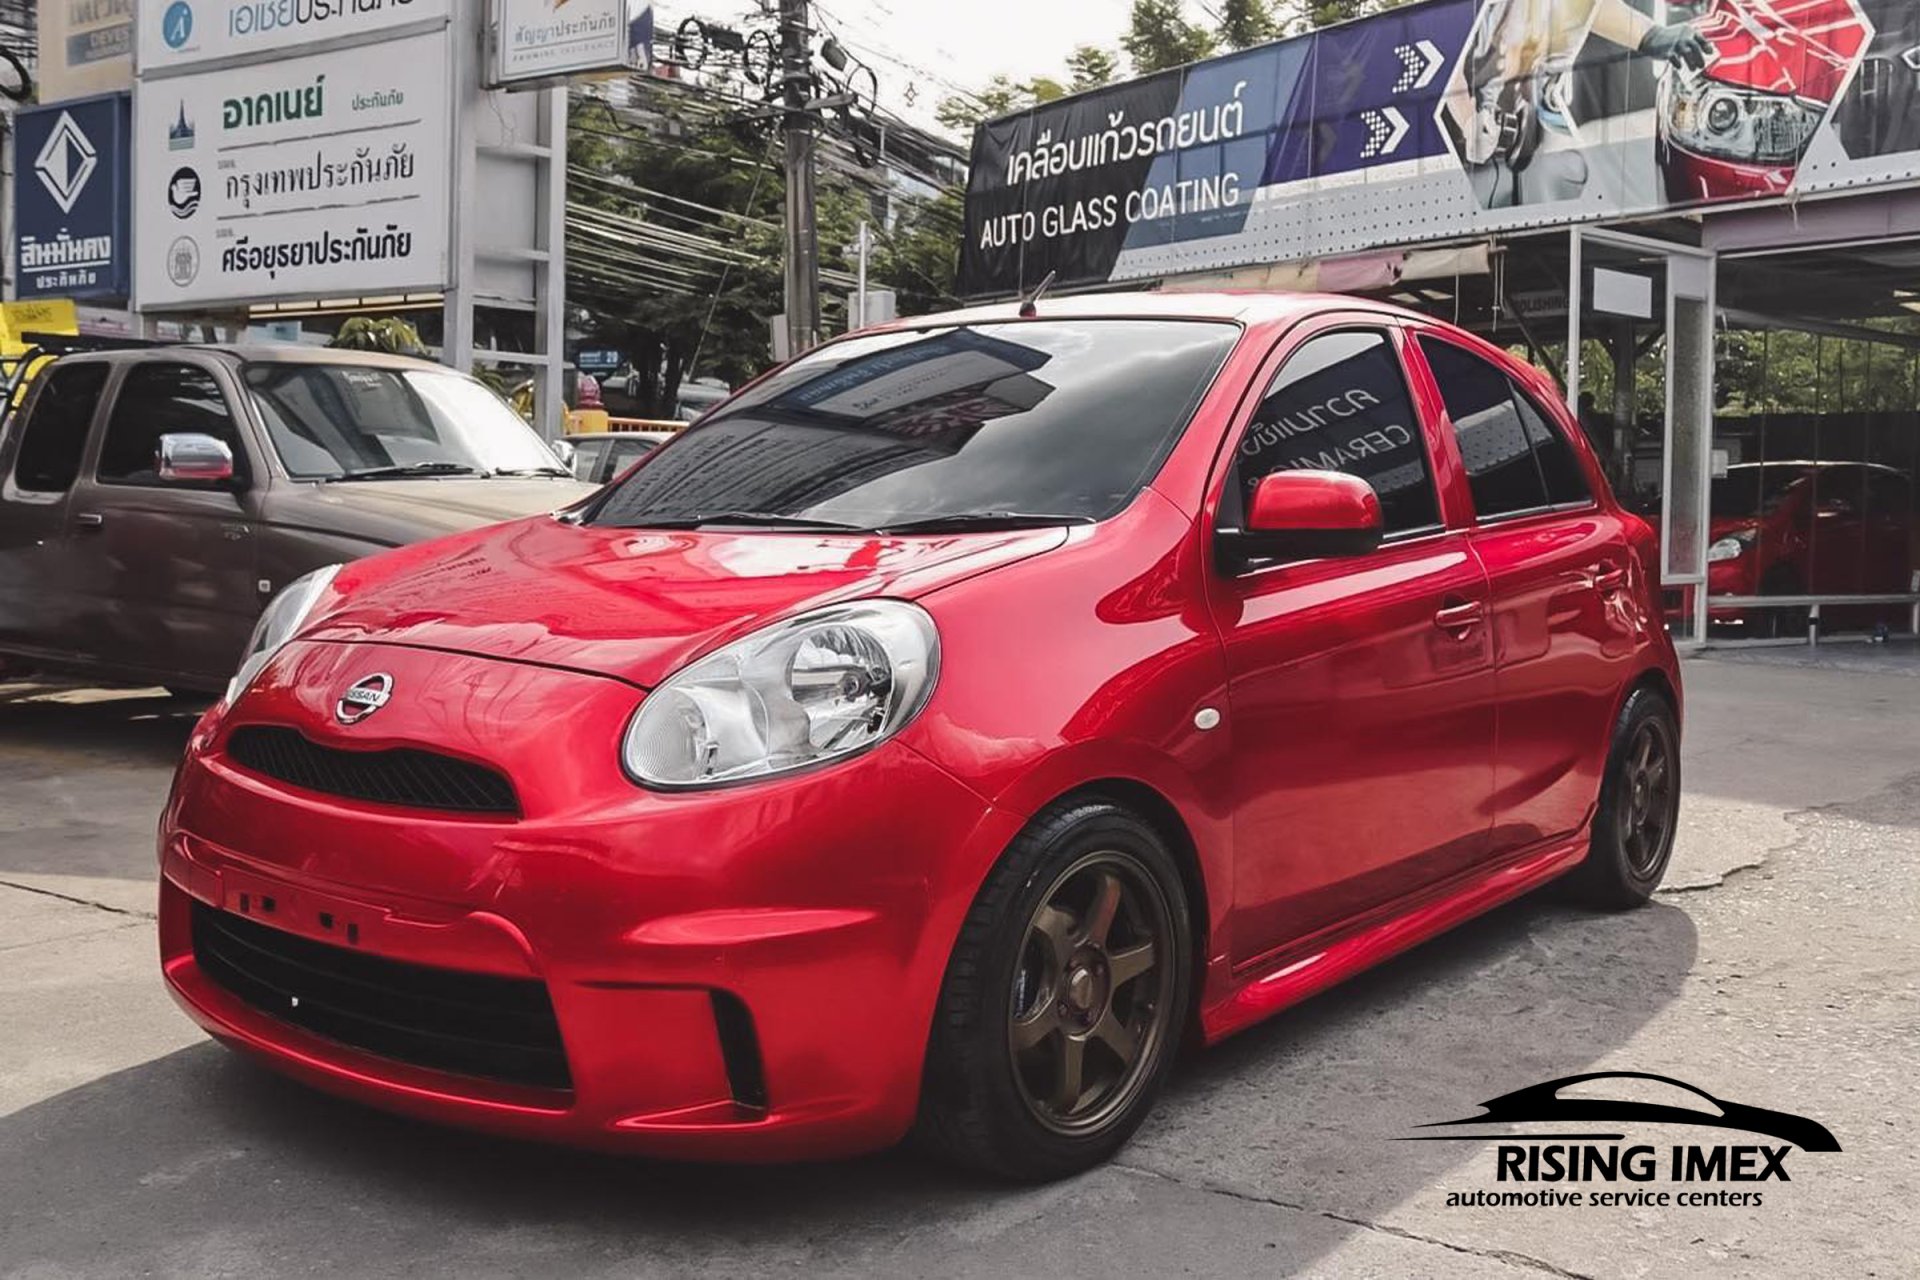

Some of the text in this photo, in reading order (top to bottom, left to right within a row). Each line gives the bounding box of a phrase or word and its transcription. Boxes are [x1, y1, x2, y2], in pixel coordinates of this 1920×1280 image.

[223, 74, 404, 130] อาคเนย์ ประกันภัย
[1006, 80, 1247, 186] เคลือบแก้วรถยนต์
[226, 142, 415, 209] กรุงเทพประกันภัย
[980, 172, 1240, 249] AUTO GLASS COATING
[21, 228, 112, 267] สินมั่นคง
[222, 224, 412, 280] ศรีอยุธยาประกันภัย
[36, 269, 97, 289] ประกันภัย
